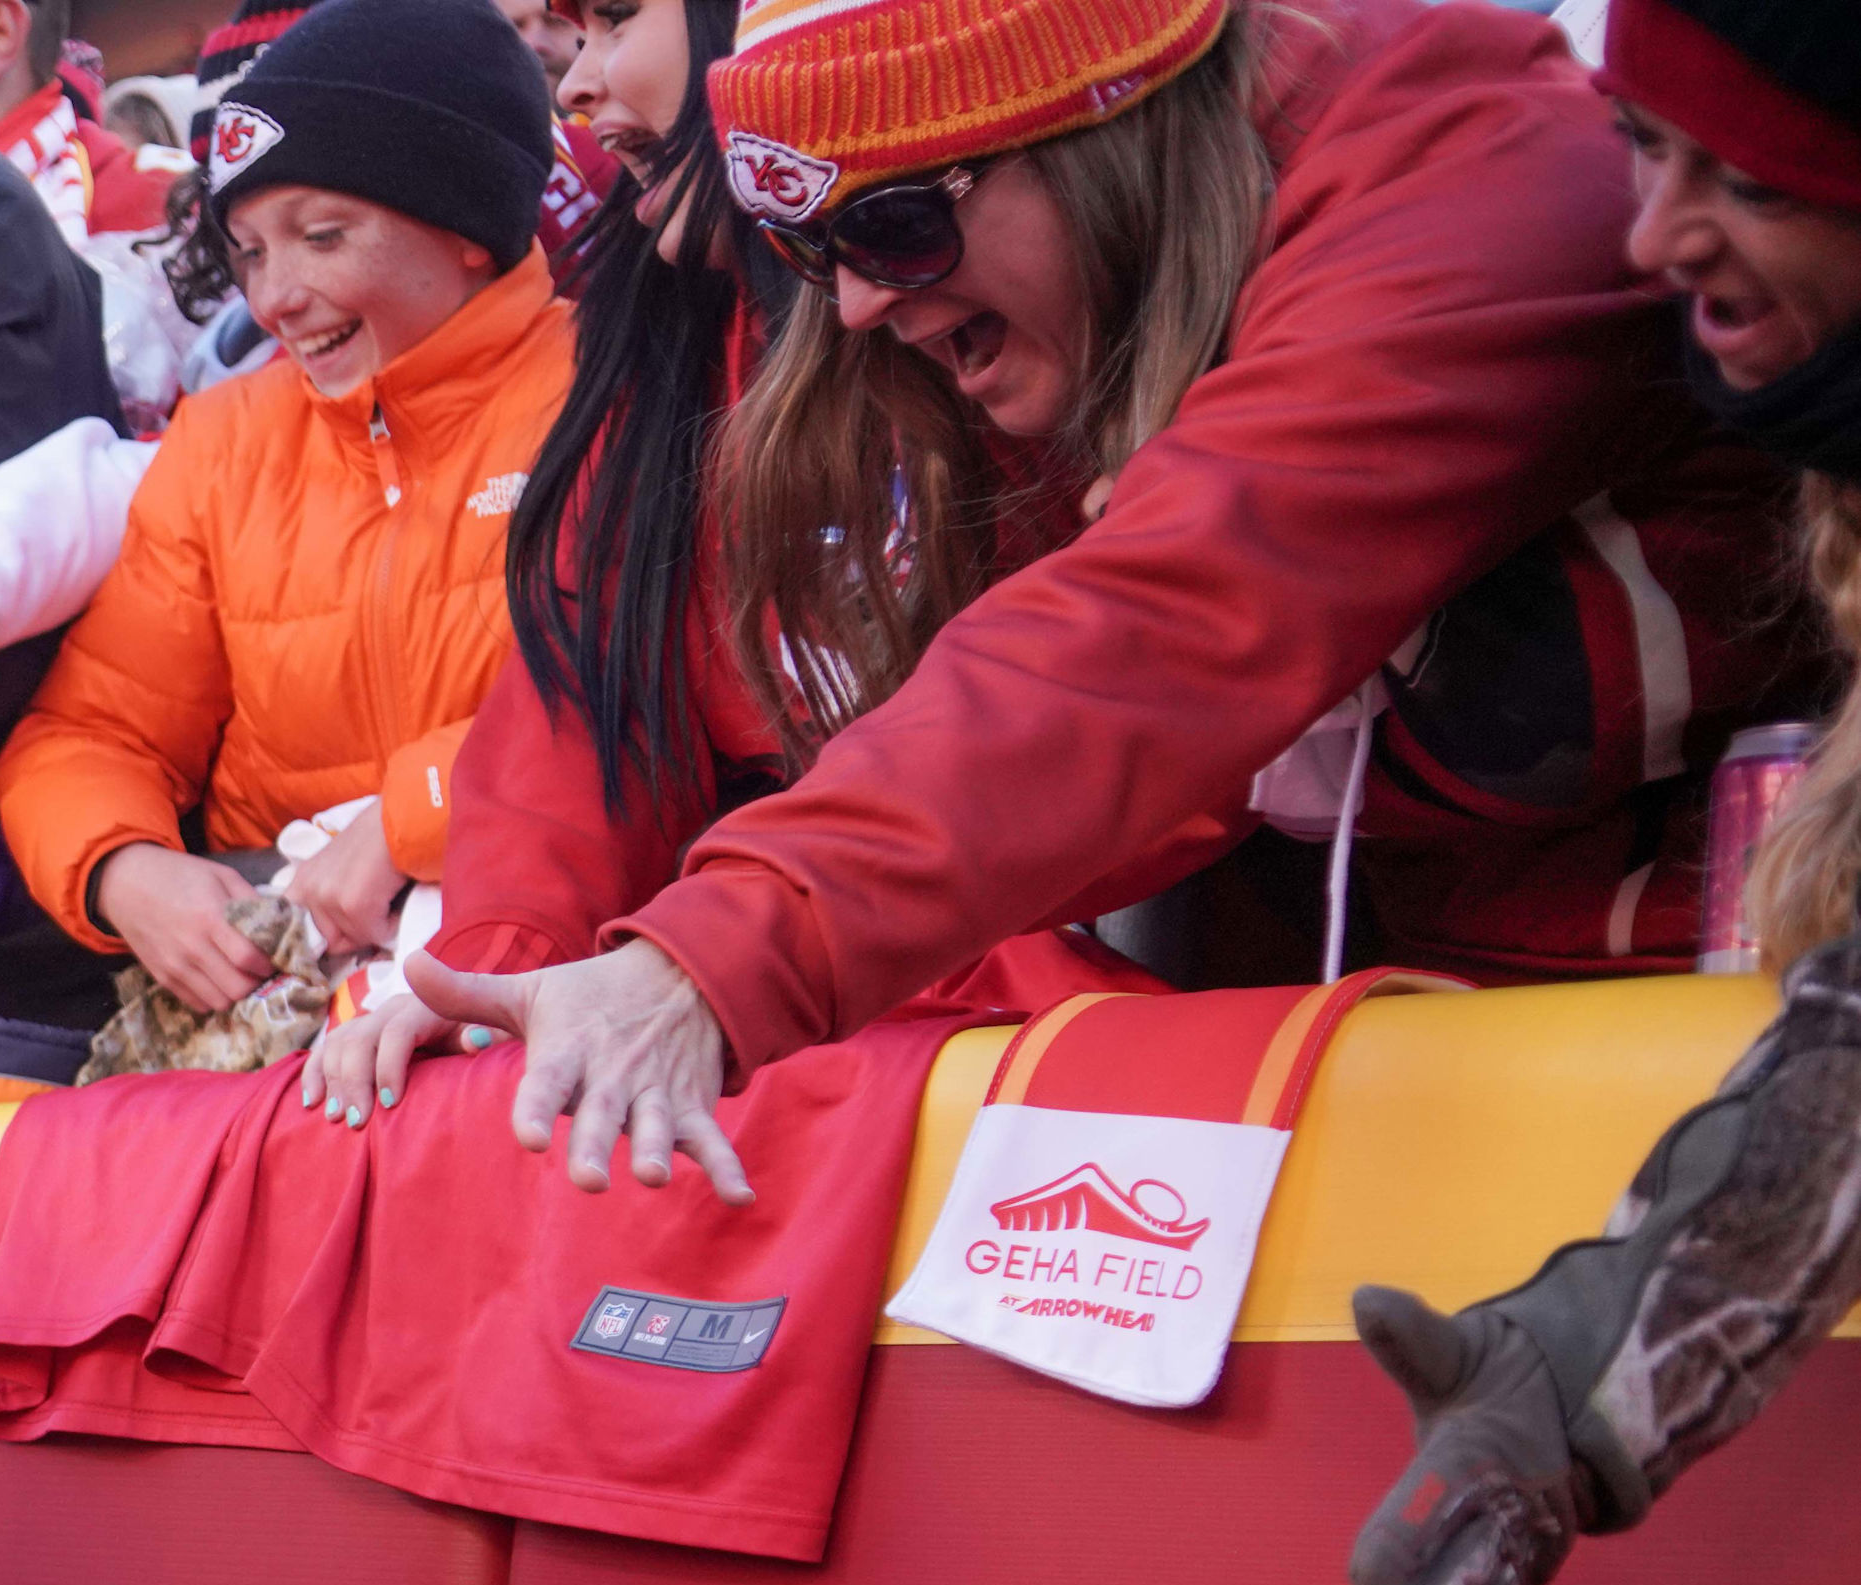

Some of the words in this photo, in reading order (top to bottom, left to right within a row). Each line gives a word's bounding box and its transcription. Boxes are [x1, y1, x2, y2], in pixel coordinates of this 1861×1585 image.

[965, 1239, 1079, 1283] GEHA
[1094, 1253, 1203, 1300] FIELD
[598, 1317, 625, 1335] NFL
[698, 1313, 735, 1340] M
[999, 1295, 1022, 1307] AT
[1015, 1297, 1156, 1333] ARROWHEAD
